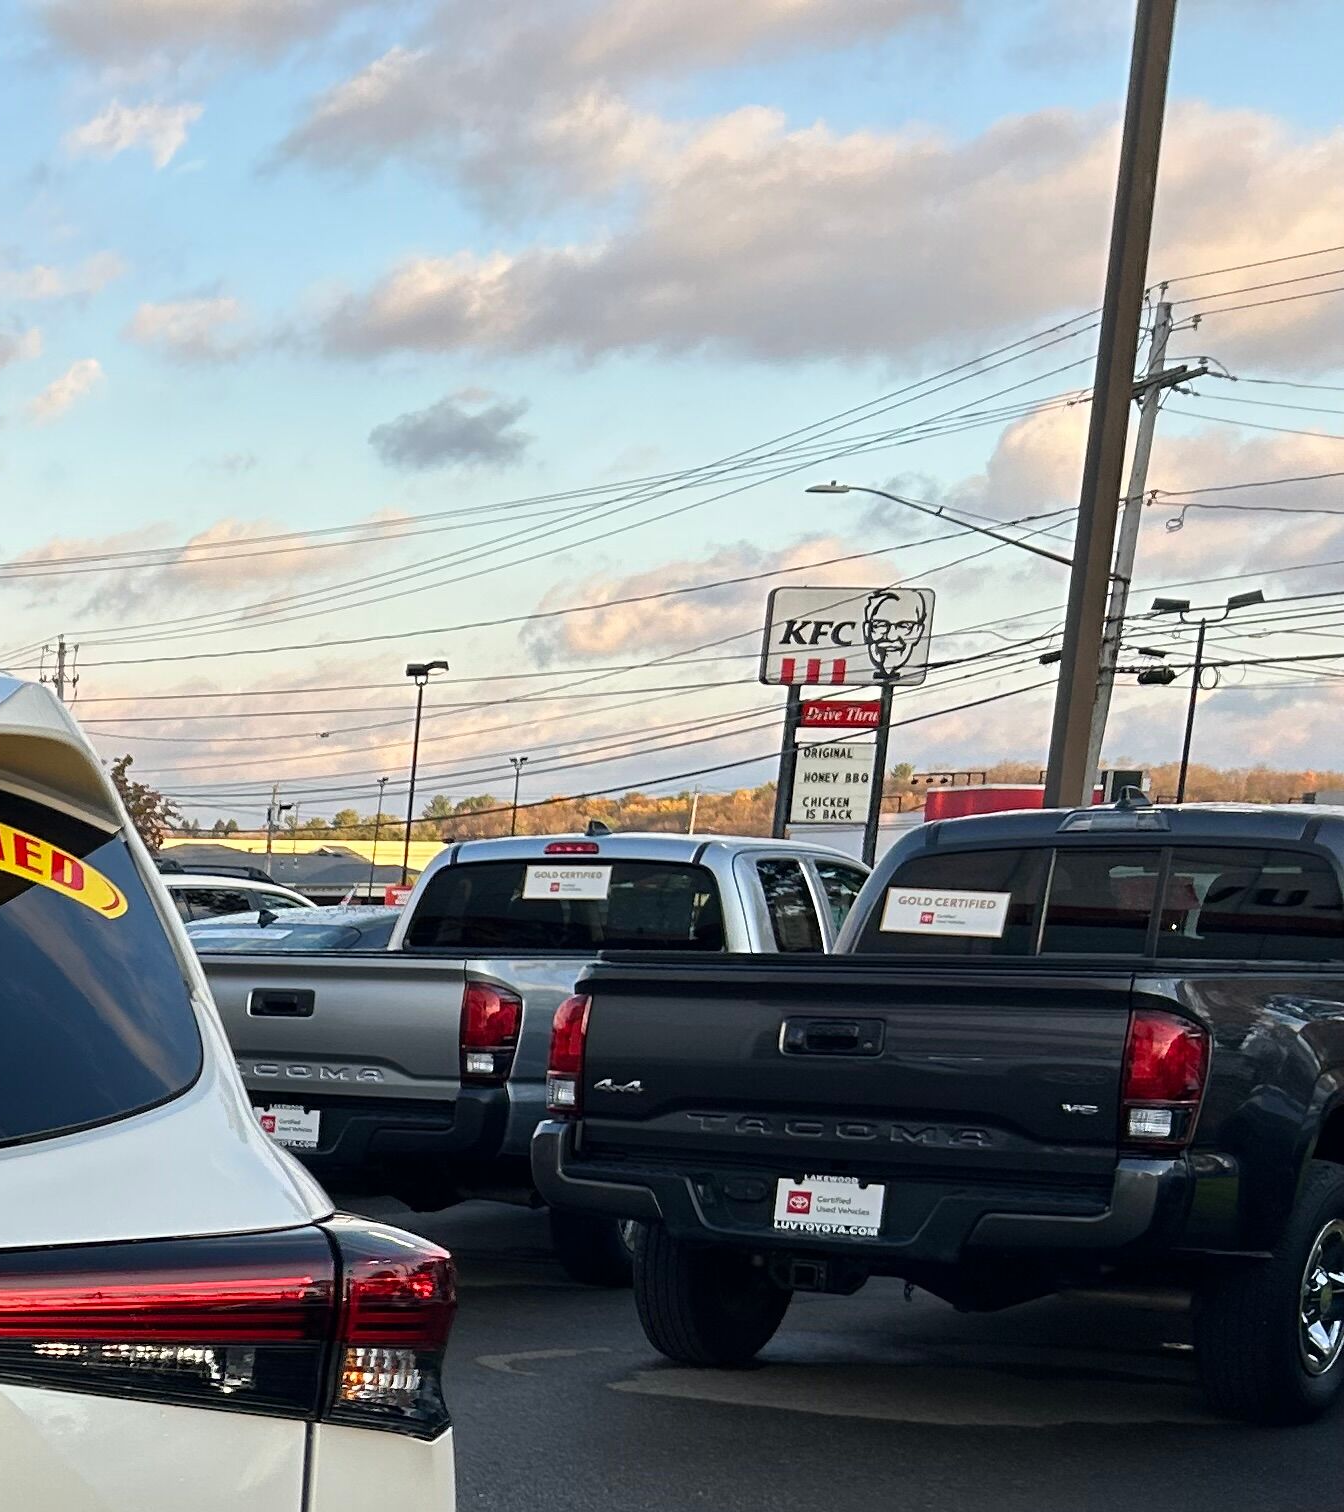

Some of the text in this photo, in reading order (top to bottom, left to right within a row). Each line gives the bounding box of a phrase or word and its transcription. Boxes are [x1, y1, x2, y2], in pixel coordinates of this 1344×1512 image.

[779, 620, 856, 646] KFC
[805, 706, 879, 722] Drive Thru
[803, 747, 853, 760] ORIGINAL
[803, 771, 869, 784] HONEY BBQ
[802, 796, 849, 808] CHICKEN
[805, 808, 852, 820] IS BACK
[534, 871, 602, 879] GOLD CERTIFIED
[898, 895, 996, 909] GOLD CERTIFIED
[237, 1062, 384, 1083] COMA
[686, 1112, 993, 1147] TACOMA
[804, 1174, 859, 1185] LAKEWOOD
[817, 1196, 852, 1205] Certified
[816, 1206, 870, 1216] Used Vehicles
[774, 1220, 878, 1237] LUVTOYOTA.COM
